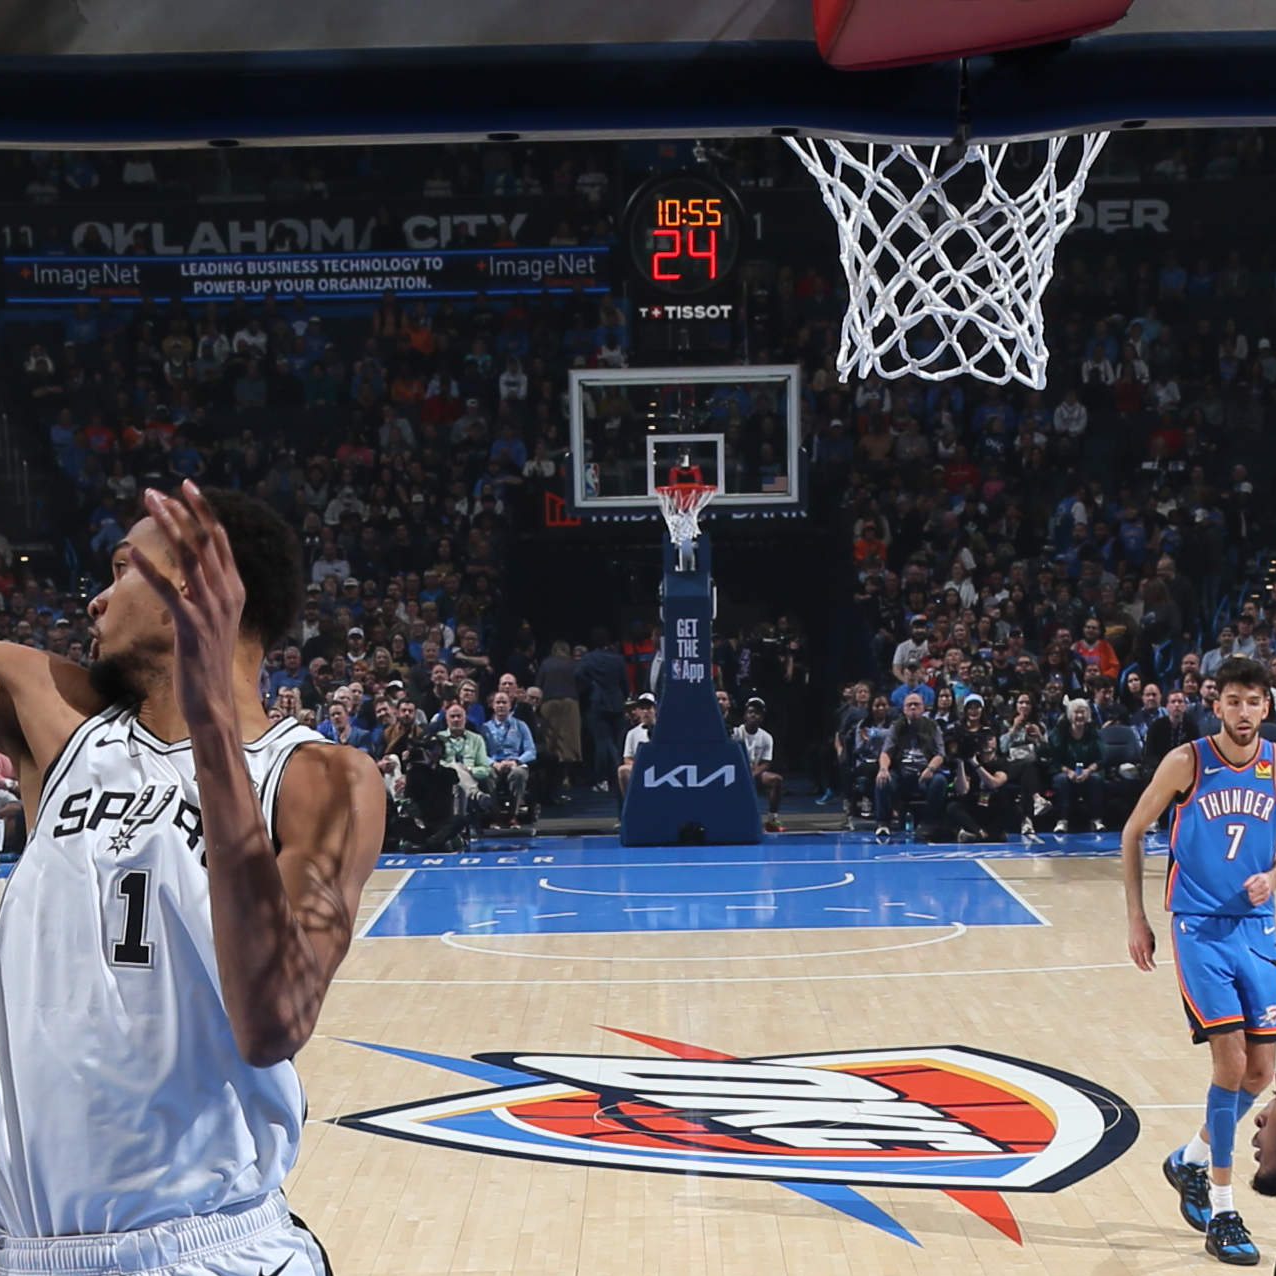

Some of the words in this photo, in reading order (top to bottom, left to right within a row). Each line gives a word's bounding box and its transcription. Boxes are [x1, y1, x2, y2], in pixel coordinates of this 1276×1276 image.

[656, 198, 722, 227] 10:55
[402, 213, 528, 251] CITY
[181, 262, 244, 277] LEADING
[247, 260, 318, 276] BUSINESS
[322, 257, 421, 274] TECHNOLOGY
[423, 256, 443, 271] TO
[489, 253, 596, 281] ImageNet
[652, 229, 718, 281] 24
[34, 263, 141, 290] ImageNet
[192, 280, 271, 295] POWER-UP
[273, 278, 315, 293] YOUR
[317, 275, 432, 291] ORGANIZATION.
[664, 304, 733, 319] TISSOT
[677, 618, 699, 639] GET
[677, 639, 700, 659] THE
[682, 663, 705, 684] App
[1198, 789, 1275, 821] THUNDER
[54, 786, 208, 868] SPUR
[1226, 823, 1245, 861] 7
[111, 869, 153, 967] 1
